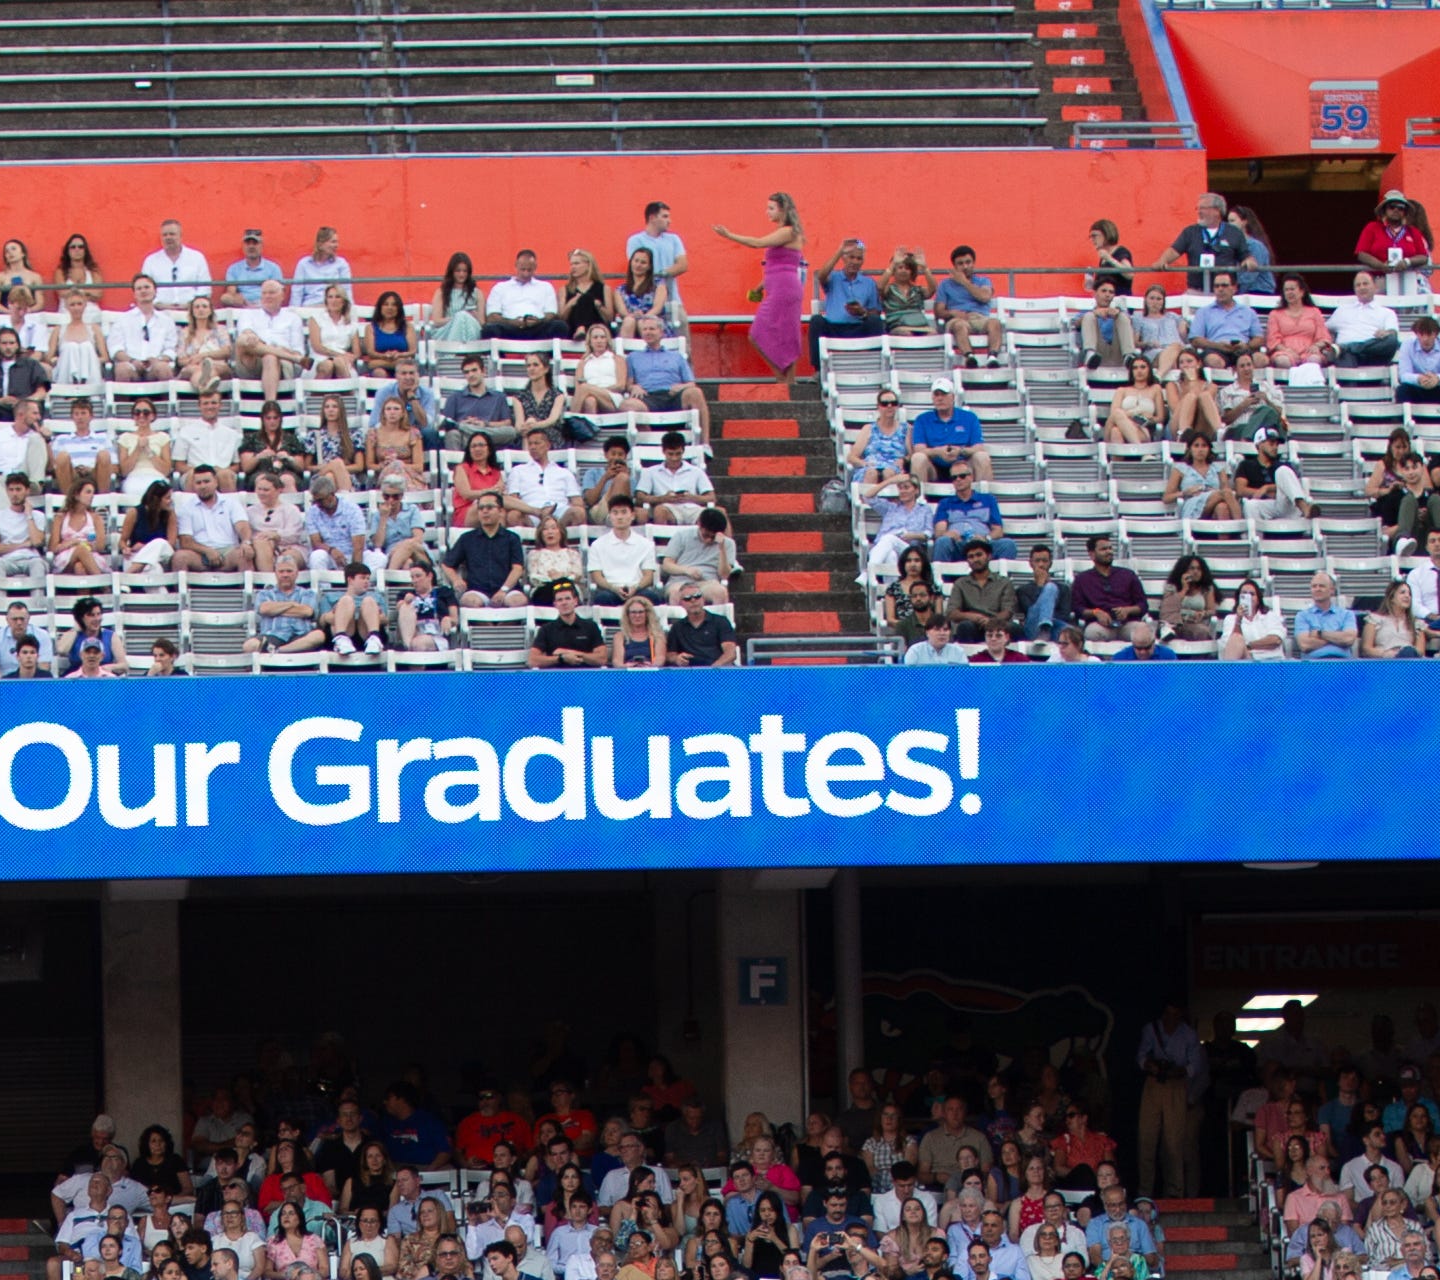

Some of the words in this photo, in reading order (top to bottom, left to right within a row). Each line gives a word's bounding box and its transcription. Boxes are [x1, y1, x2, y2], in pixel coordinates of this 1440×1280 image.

[1320, 104, 1369, 132] 59
[268, 707, 982, 825] Graduates!
[1203, 942, 1400, 971] ENTRANCE
[750, 966, 776, 999] F
